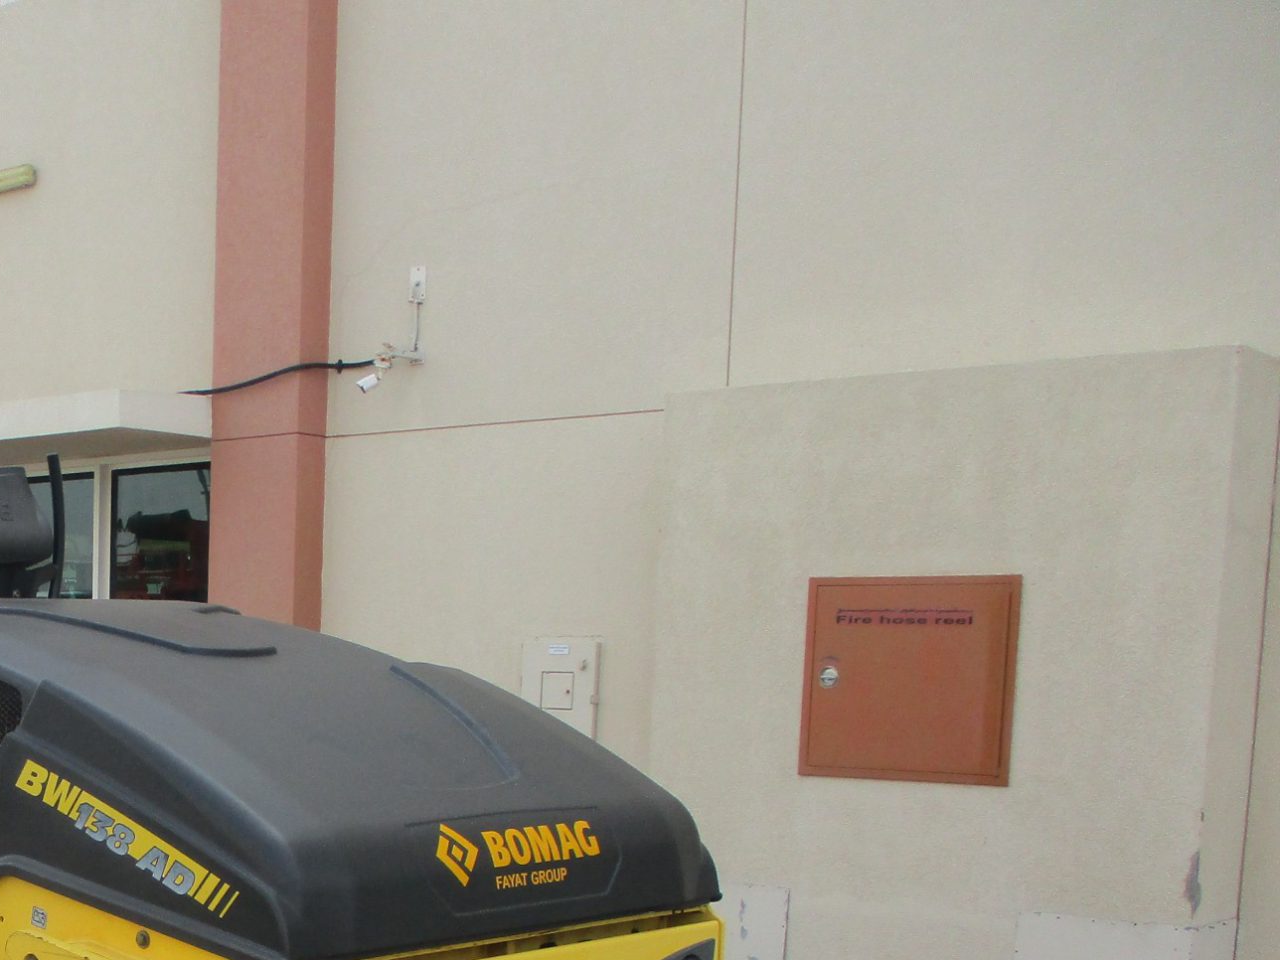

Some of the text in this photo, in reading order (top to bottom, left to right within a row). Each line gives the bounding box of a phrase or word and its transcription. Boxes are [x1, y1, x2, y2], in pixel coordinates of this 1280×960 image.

[836, 615, 973, 625] Fire hose reel
[480, 820, 601, 868] BOMAG
[135, 845, 196, 896] AD
[495, 867, 568, 891] FAYAT GROUP
